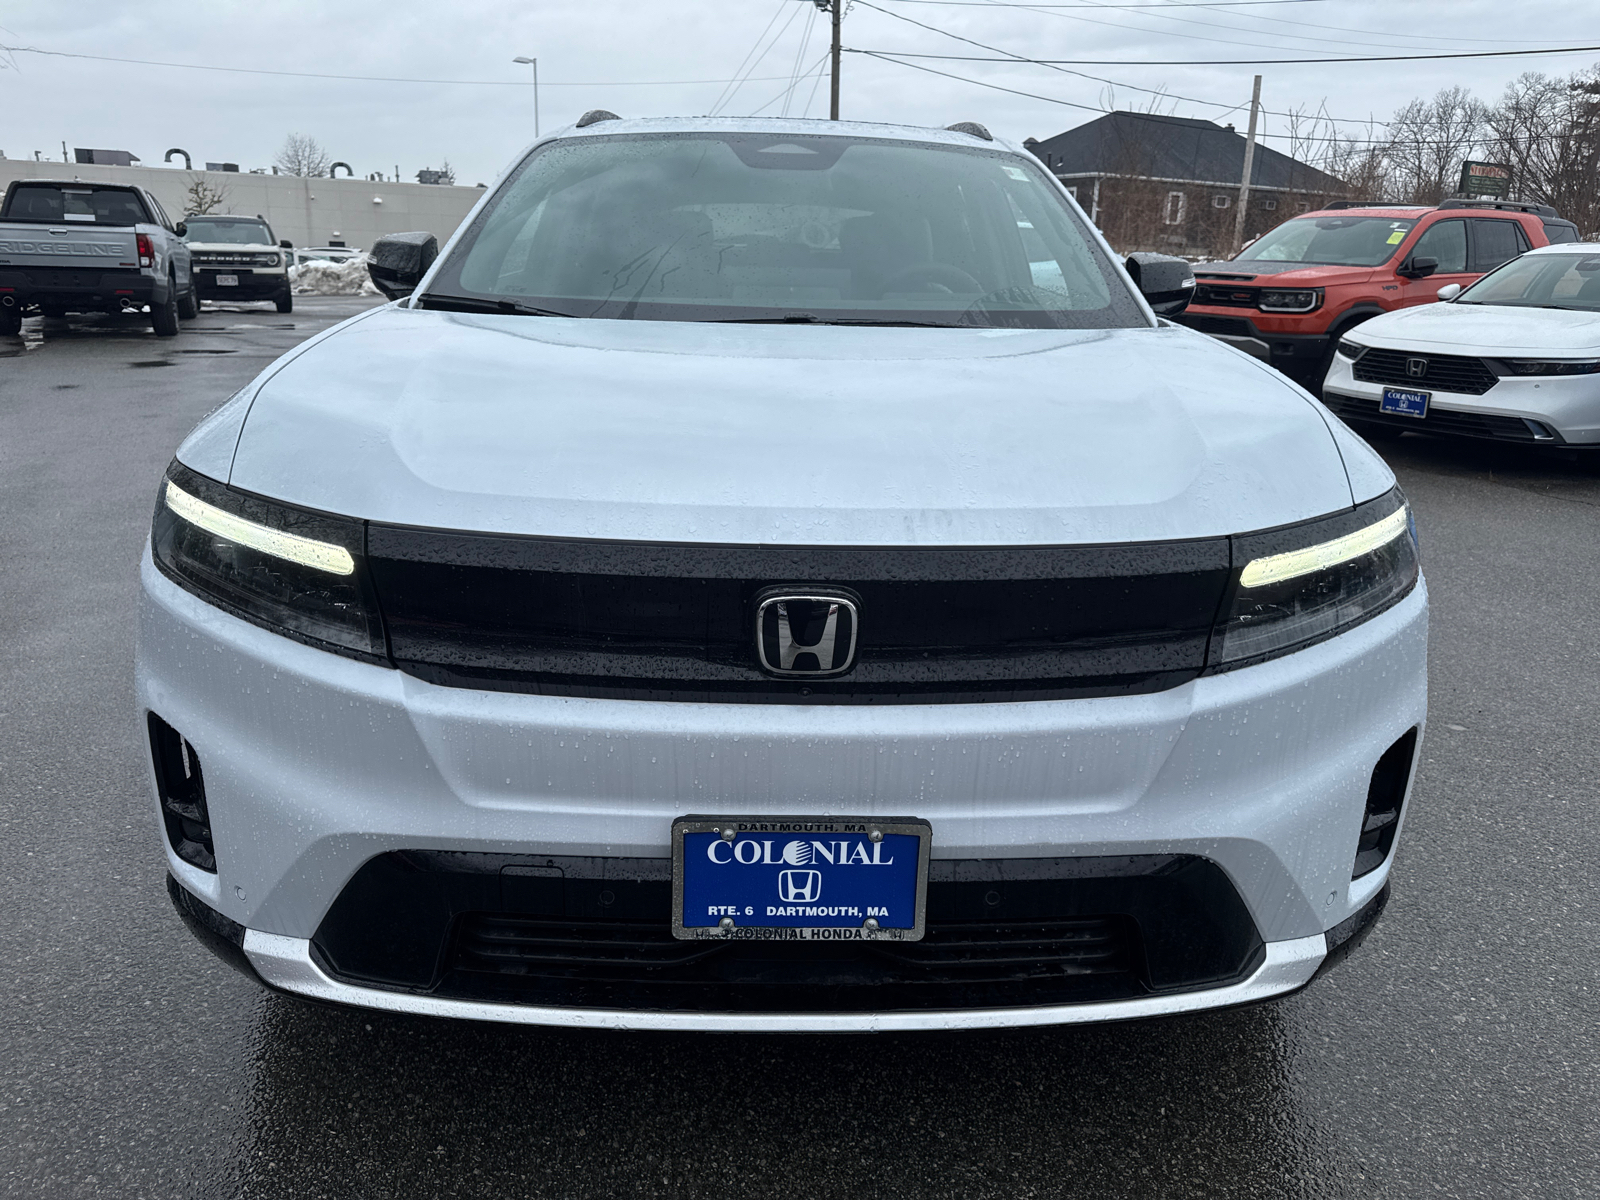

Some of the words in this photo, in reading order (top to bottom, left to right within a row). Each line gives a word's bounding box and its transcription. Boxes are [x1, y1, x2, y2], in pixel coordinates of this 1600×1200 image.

[0, 241, 124, 256] RIDGELINE
[1388, 391, 1422, 402] COLONIAL
[844, 824, 867, 832] MA
[707, 839, 894, 866] COLONIAL
[707, 905, 741, 916] RTE.
[744, 906, 754, 916] 6
[766, 906, 863, 918] DARTMOUTH,
[867, 906, 889, 917] MA
[735, 928, 807, 940] COLONIAL
[811, 928, 863, 939] HONDA
